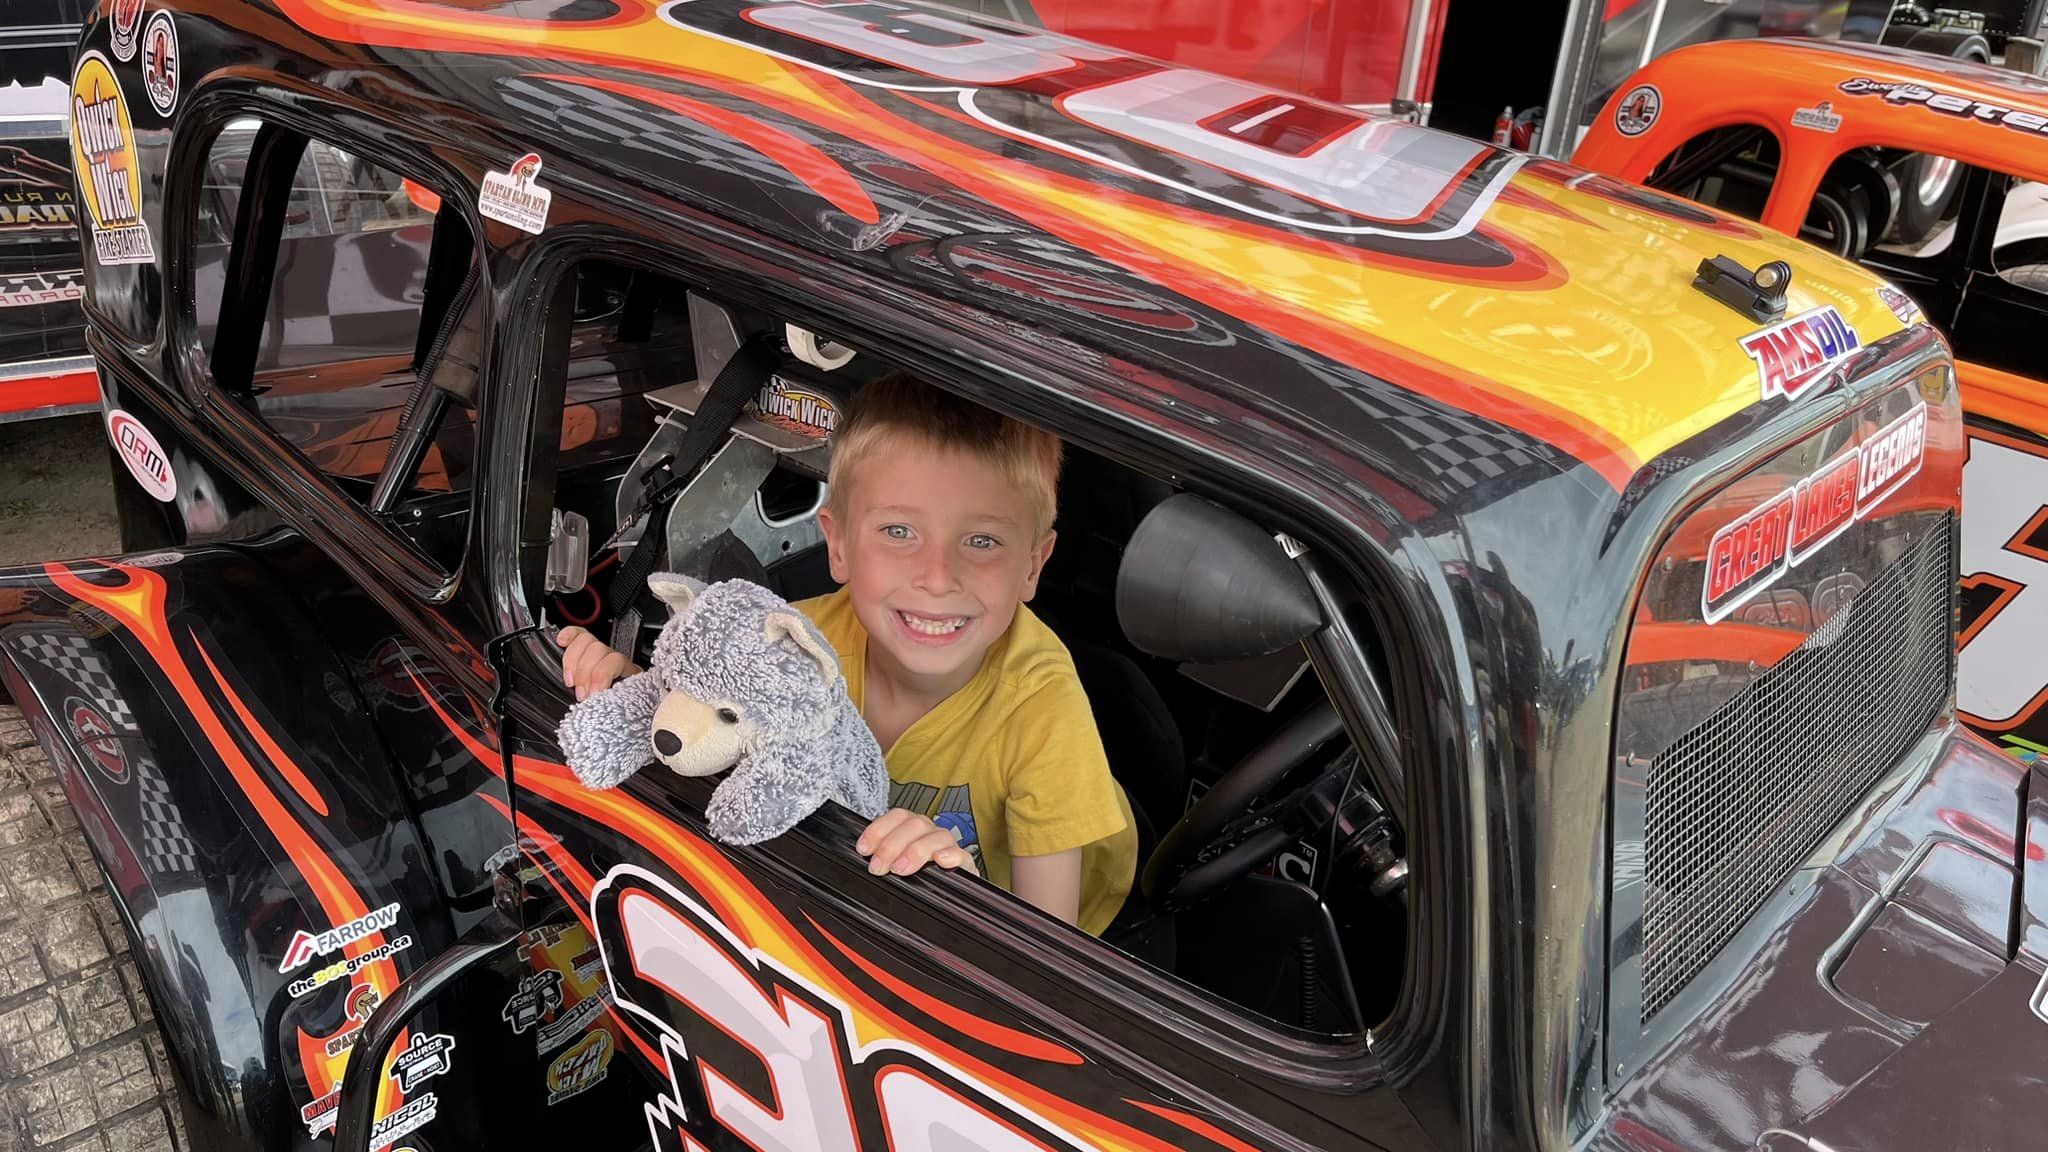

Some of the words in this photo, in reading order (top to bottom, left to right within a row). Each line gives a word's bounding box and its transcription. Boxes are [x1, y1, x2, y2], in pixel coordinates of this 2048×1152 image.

[1745, 309, 1857, 393] AMSOIL
[1708, 498, 1792, 603] GREAT
[1792, 459, 1858, 548] LAKES
[1858, 412, 1924, 501] LEGENDS
[316, 911, 395, 953] FARROW
[398, 1038, 443, 1066] SOURCE
